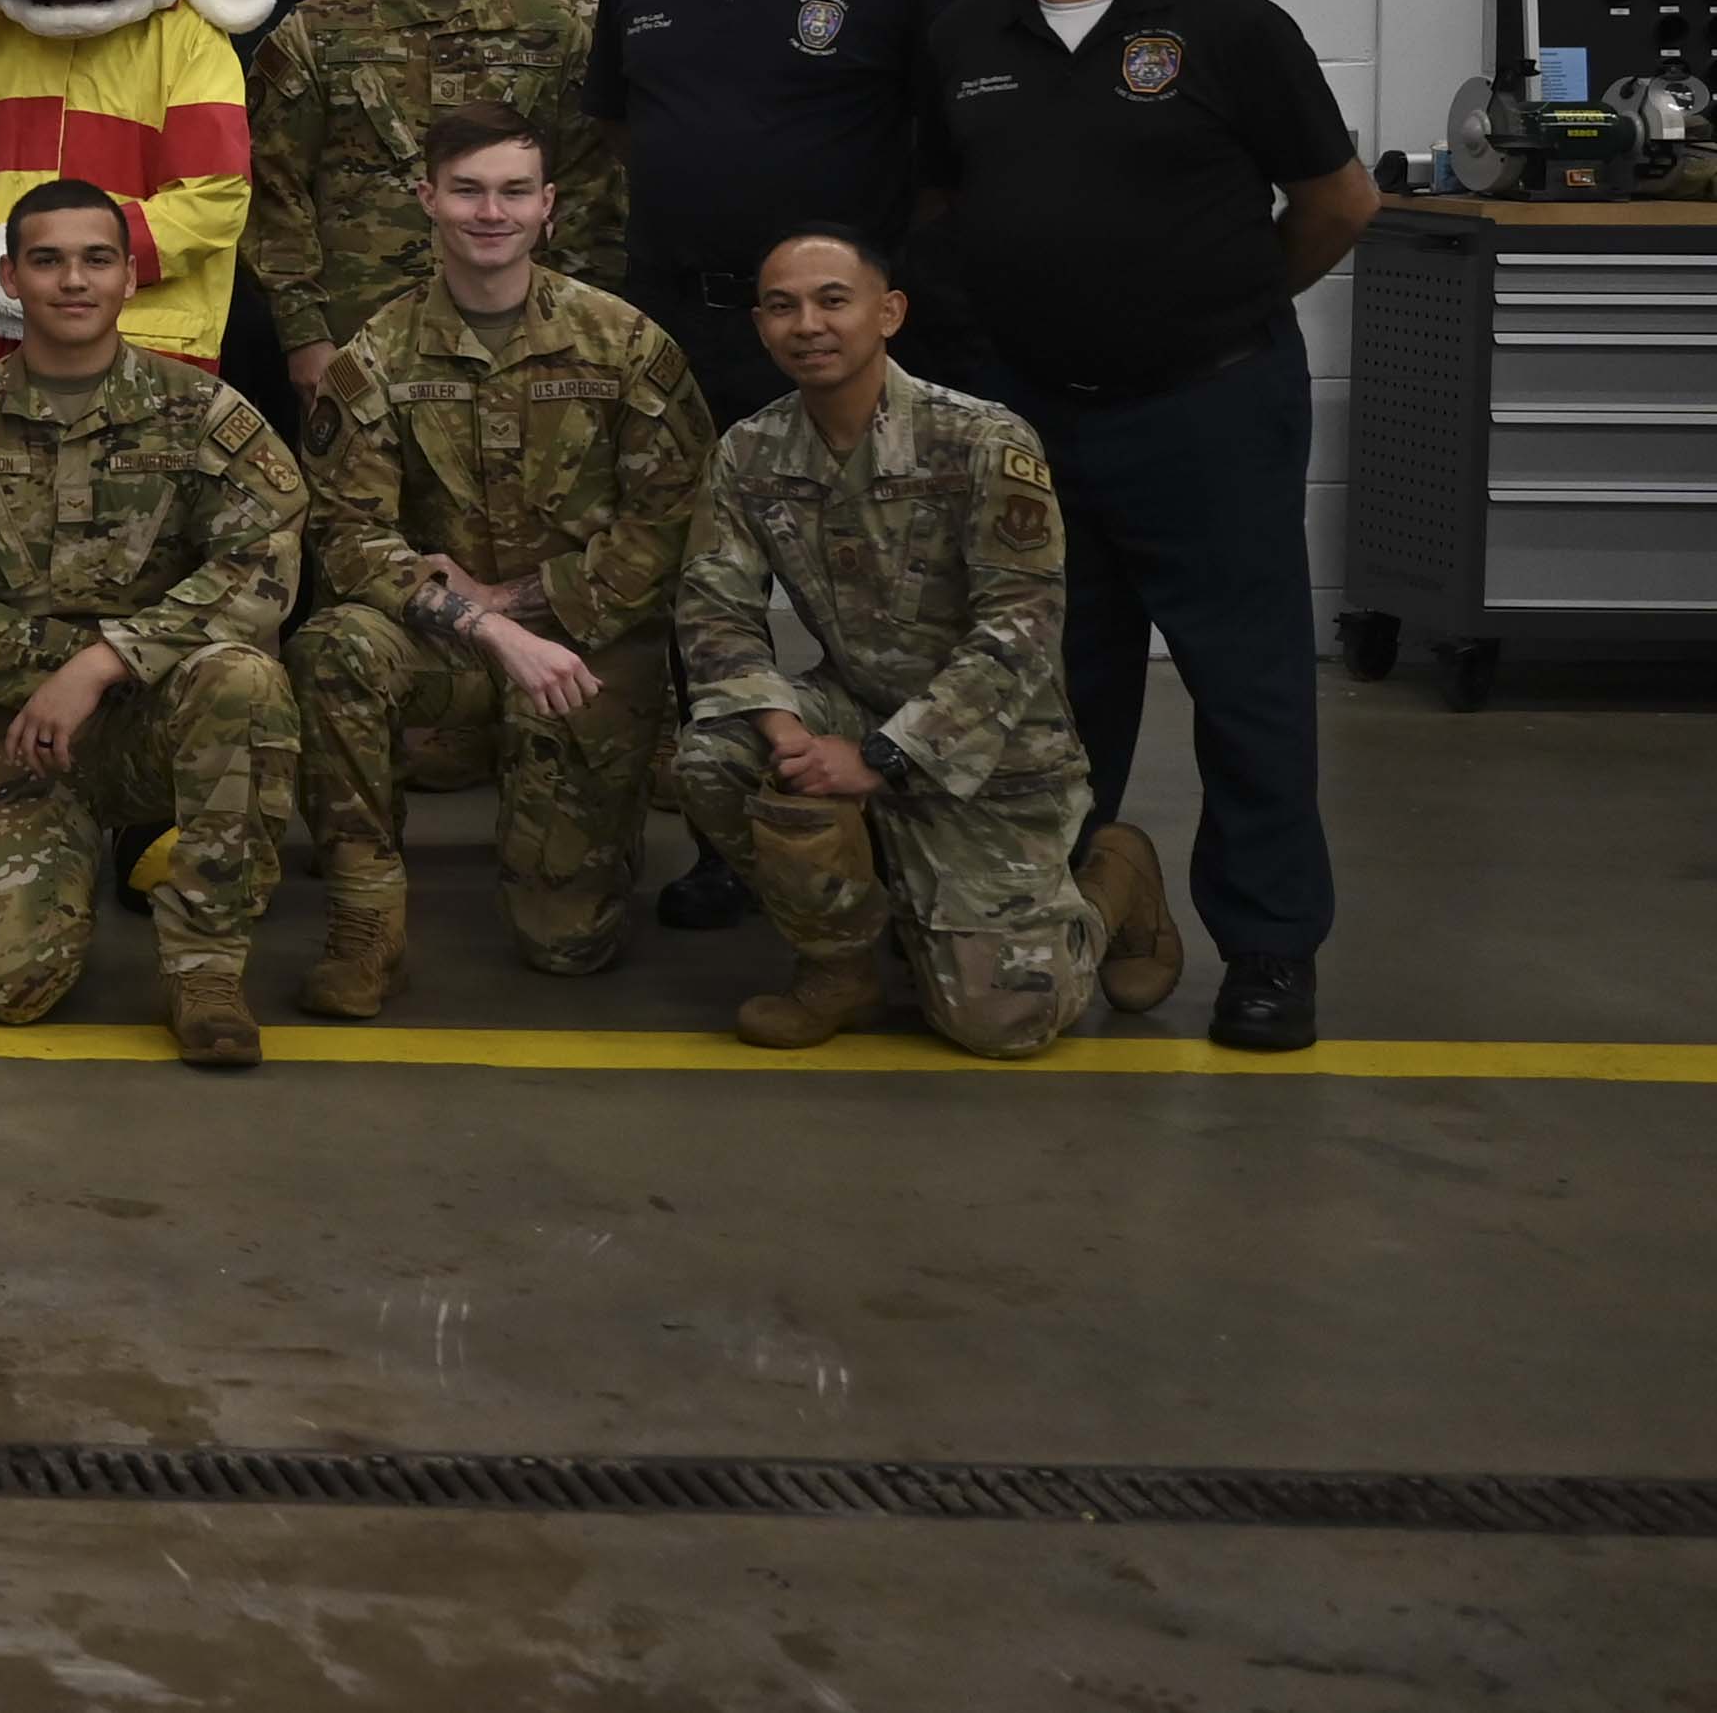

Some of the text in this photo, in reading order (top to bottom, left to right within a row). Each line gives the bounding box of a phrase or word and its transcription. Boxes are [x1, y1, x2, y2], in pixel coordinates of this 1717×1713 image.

[558, 383, 577, 397] AIR
[579, 382, 614, 397] FORCE
[224, 407, 260, 448] FIRE
[1011, 453, 1048, 486] CE
